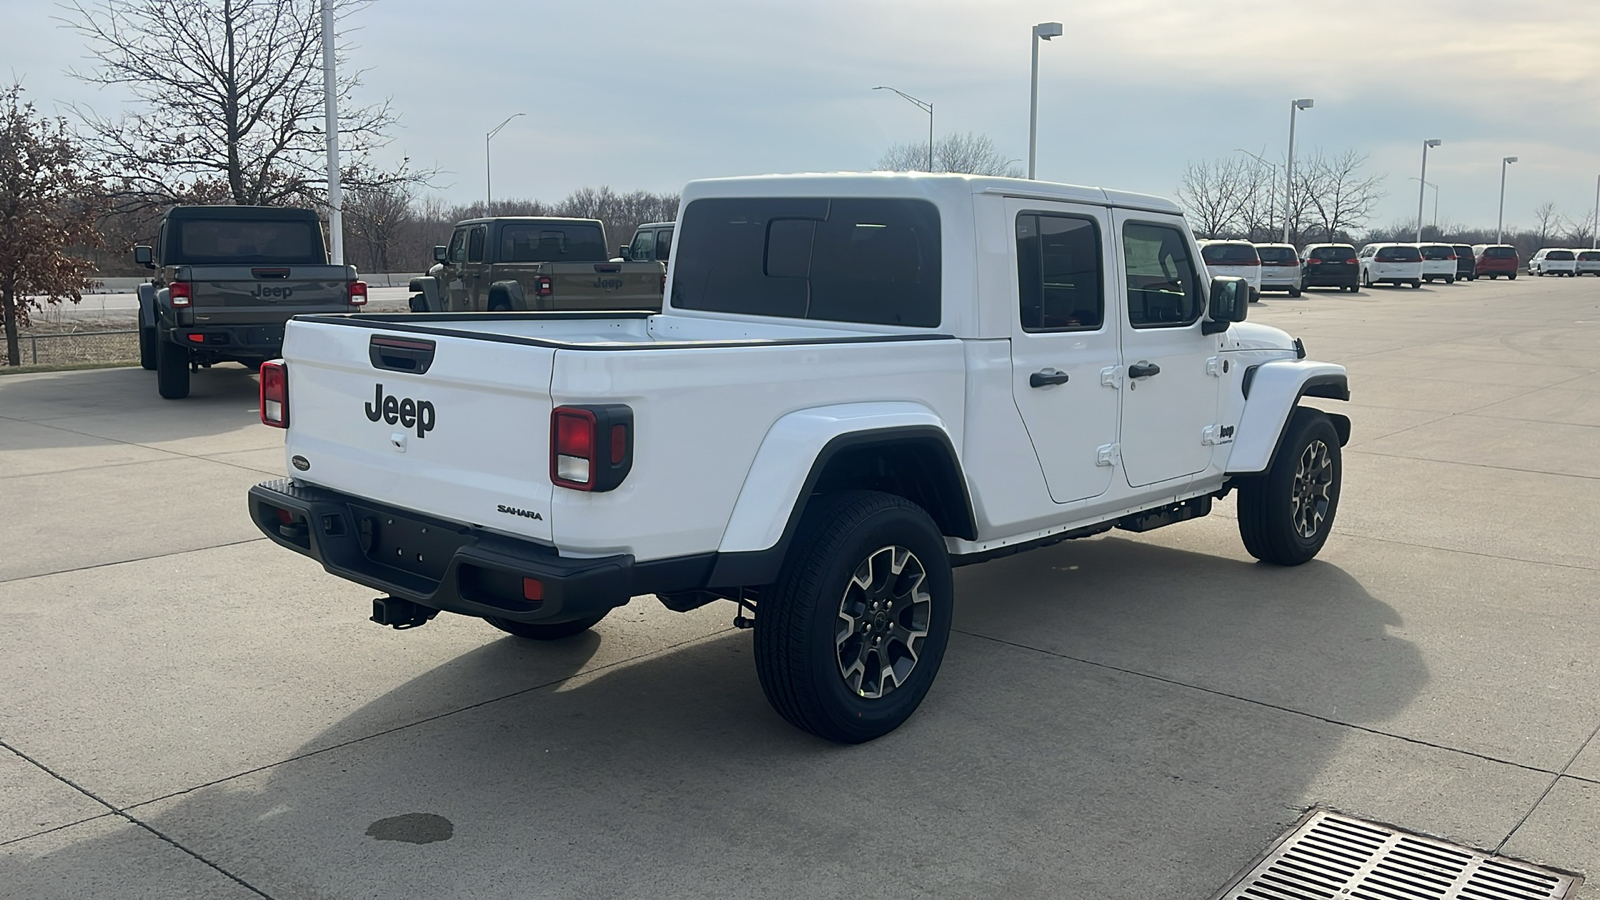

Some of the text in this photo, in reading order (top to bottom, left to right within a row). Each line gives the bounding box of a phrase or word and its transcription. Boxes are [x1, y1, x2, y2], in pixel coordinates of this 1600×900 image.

[251, 283, 293, 299] Jeep
[593, 277, 622, 289] Jeep
[365, 383, 435, 438] Jeep
[497, 504, 543, 521] SAHARA
